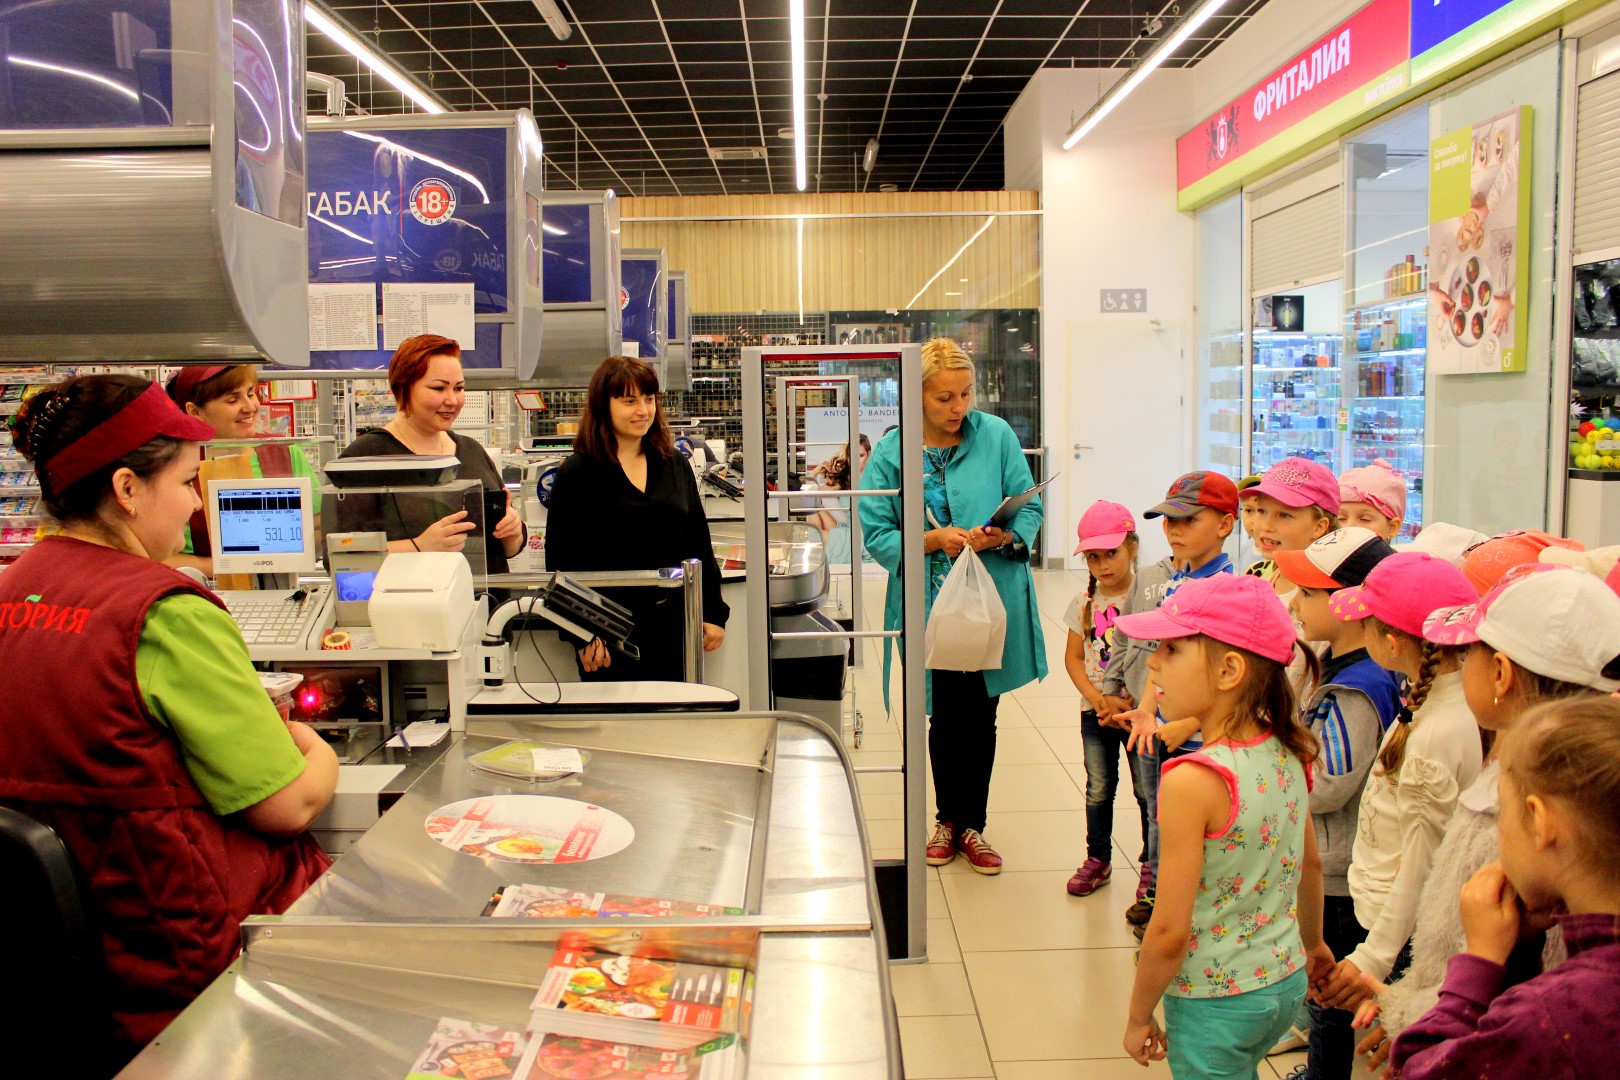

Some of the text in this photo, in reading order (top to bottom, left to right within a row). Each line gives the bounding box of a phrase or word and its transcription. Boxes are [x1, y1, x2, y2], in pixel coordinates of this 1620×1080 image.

[1253, 28, 1350, 121] ФРИТАЛИЯ
[1364, 73, 1403, 105] ВИКТОРИЯ
[1434, 142, 1458, 160] Спасибо
[1442, 150, 1467, 169] покупку!
[308, 190, 391, 216] ТАБАК
[418, 191, 449, 213] 18+
[265, 527, 302, 541] 531.10
[0, 602, 92, 634] ТОРИЯ
